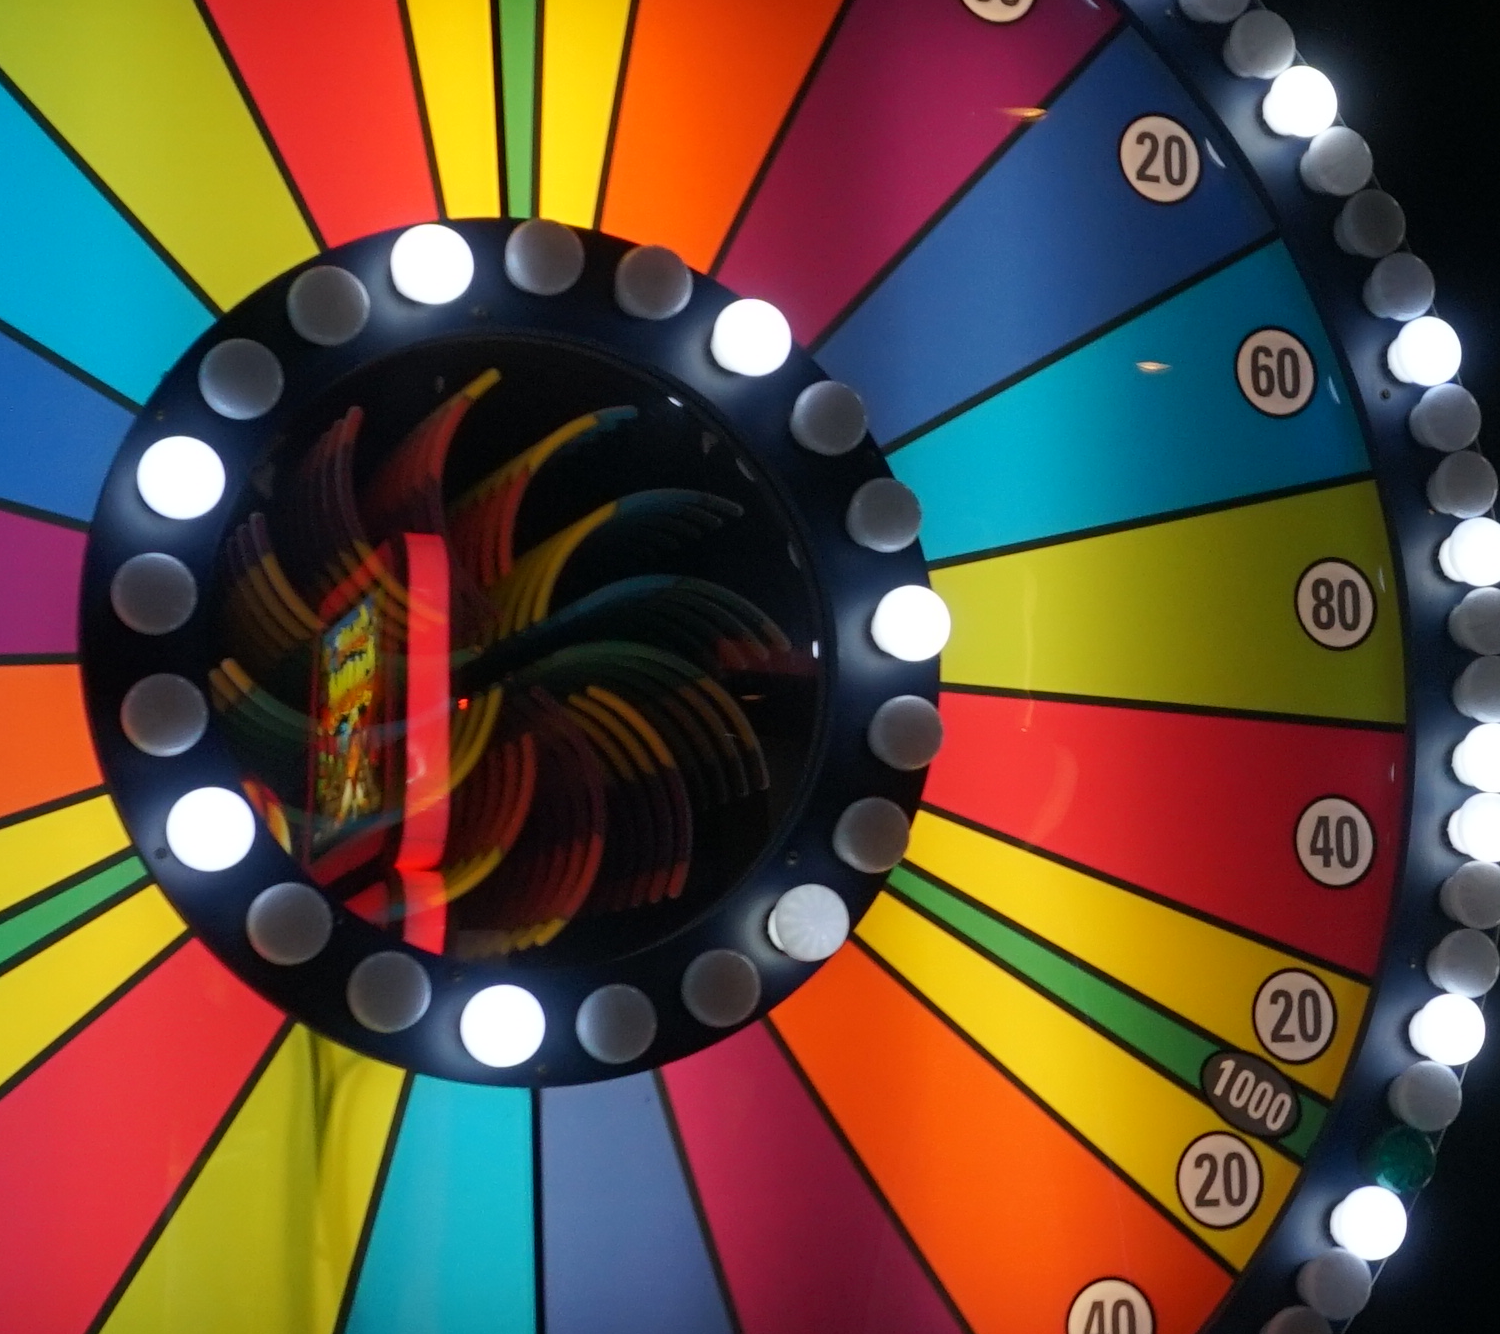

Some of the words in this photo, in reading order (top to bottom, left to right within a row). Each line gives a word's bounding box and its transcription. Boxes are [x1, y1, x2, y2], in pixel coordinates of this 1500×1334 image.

[1136, 130, 1188, 185] 20
[1251, 344, 1301, 399] 60
[1313, 577, 1362, 631] 80
[1311, 813, 1360, 868] 40
[1269, 989, 1322, 1044] 20
[1212, 1059, 1292, 1131] 1000
[1195, 1152, 1249, 1207] 20
